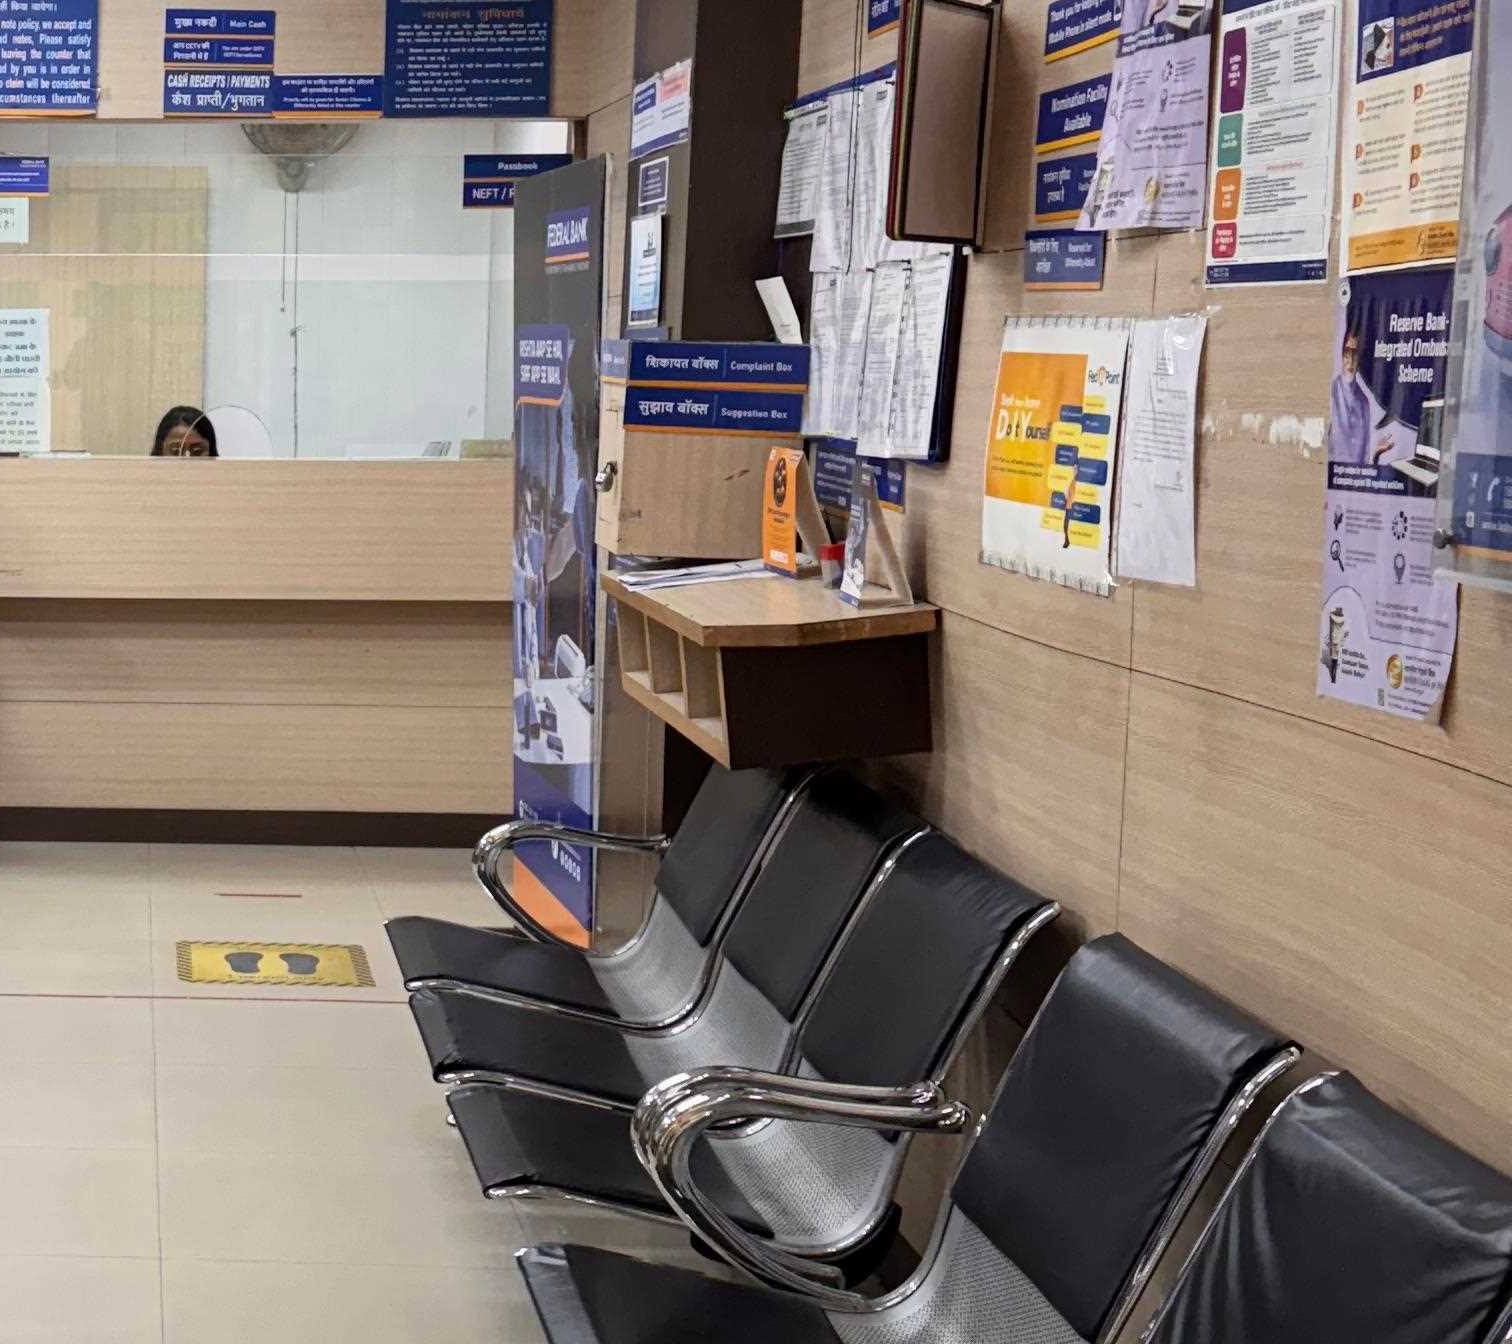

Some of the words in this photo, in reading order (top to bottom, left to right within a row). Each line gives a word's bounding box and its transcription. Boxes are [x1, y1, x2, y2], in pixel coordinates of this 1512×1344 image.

[42, 20, 52, 29] we
[78, 18, 92, 29] and
[248, 20, 266, 28] Cash
[40, 33, 63, 45] Please
[30, 48, 42, 59] the
[46, 48, 73, 59] counter
[11, 63, 19, 76] by
[23, 66, 36, 76] you
[61, 63, 80, 73] order
[40, 78, 49, 89] be
[168, 74, 189, 87] CASH
[190, 75, 225, 88] RECEIPTS
[230, 75, 270, 88] PAYMENTS
[52, 93, 90, 104] thereafter
[1051, 90, 1086, 113] Nomination
[1064, 114, 1092, 132] Available
[497, 162, 538, 170] Passbook
[472, 188, 499, 199] NEFT
[547, 223, 570, 247] FEDERAL
[571, 217, 588, 244] BANK
[1389, 314, 1424, 332] Reserve
[1374, 339, 1413, 361] Integrated
[645, 354, 689, 369] शिकायत
[692, 357, 720, 370] बॉक्स
[731, 361, 774, 373] Complaint
[776, 362, 792, 372] Box
[1398, 364, 1433, 383] Scheme
[639, 400, 675, 417] सुझाव
[677, 399, 709, 415] बॉक्स
[721, 408, 768, 419] Suggestion
[771, 409, 787, 419] Box
